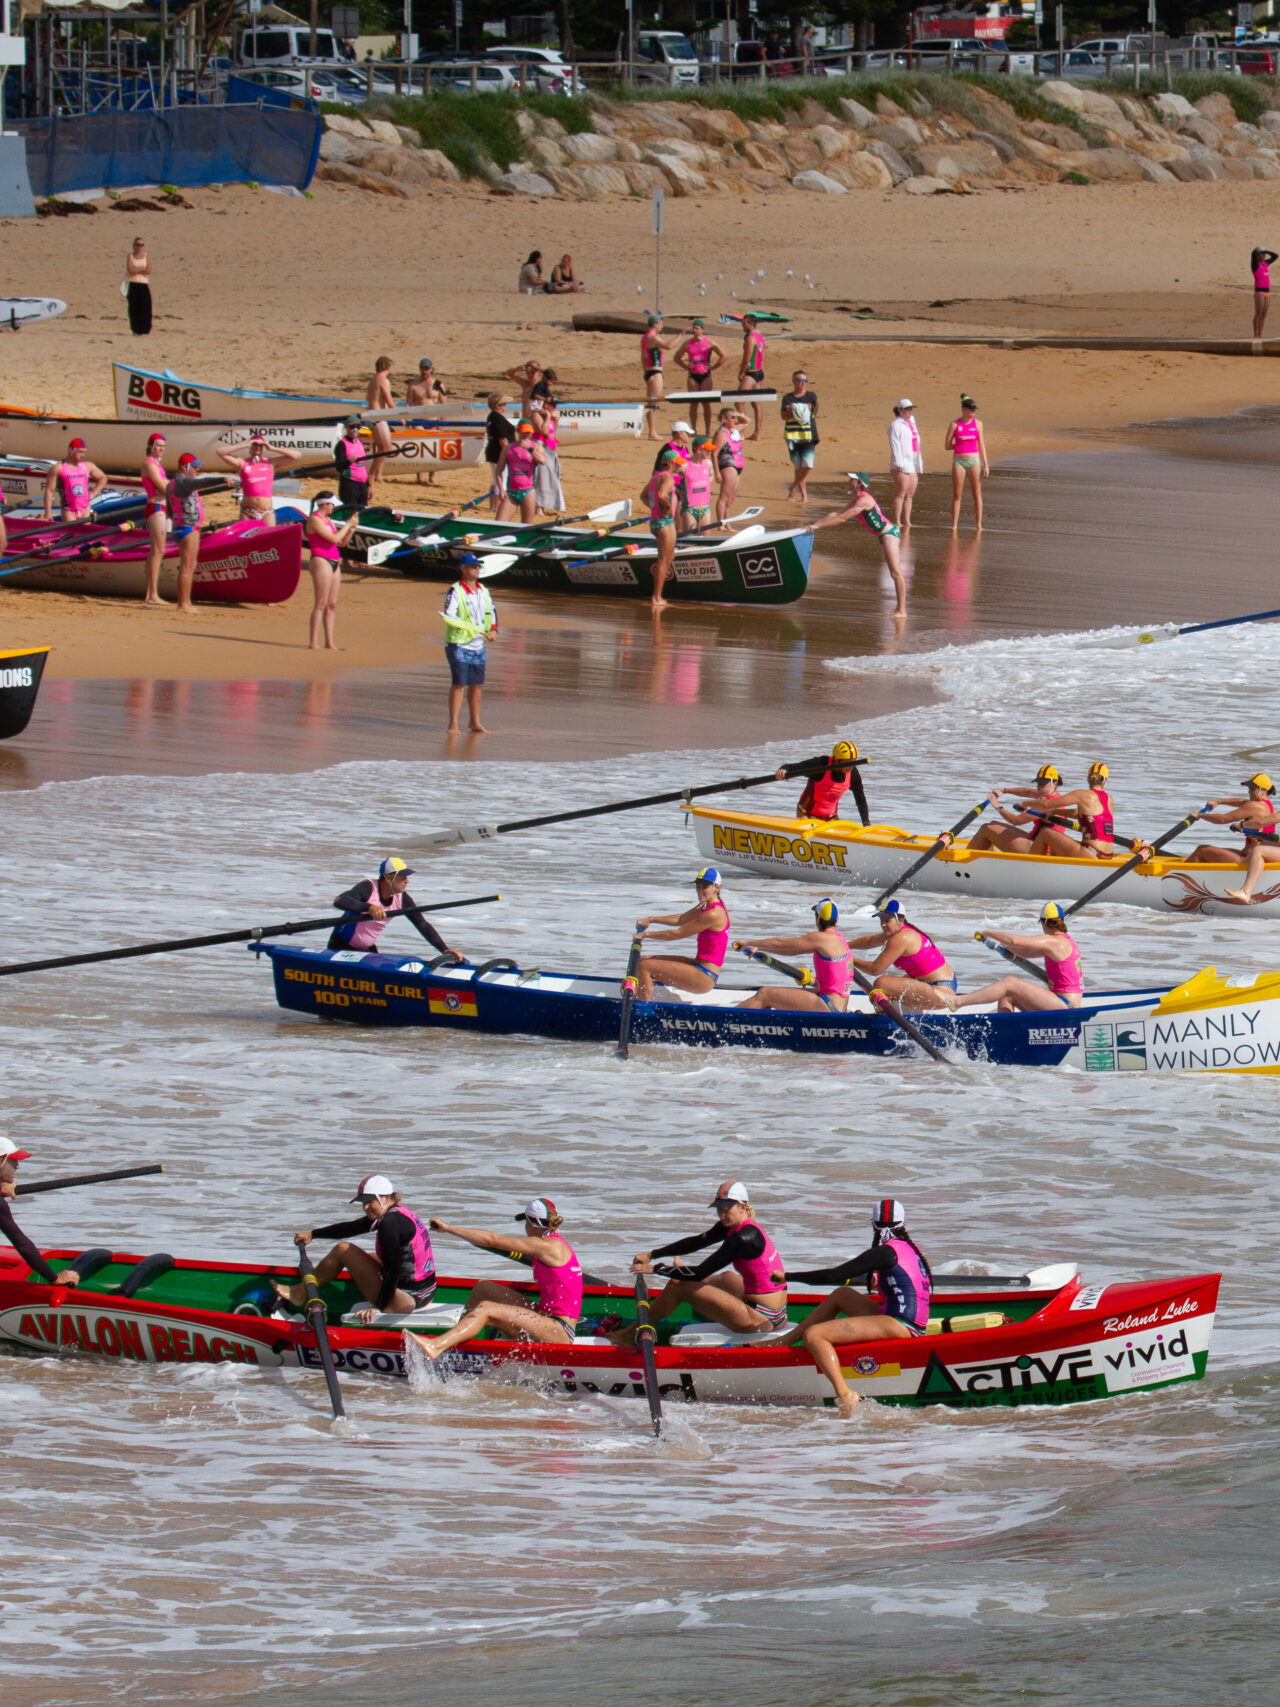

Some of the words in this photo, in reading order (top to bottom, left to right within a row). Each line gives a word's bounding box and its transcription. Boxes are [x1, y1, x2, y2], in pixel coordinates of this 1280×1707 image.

[128, 374, 201, 410] BORG
[560, 410, 601, 418] NORTH
[249, 428, 295, 437] NORTH
[677, 567, 697, 575] YOU
[700, 566, 717, 575] DIG
[713, 824, 849, 867] NEWPORT
[714, 849, 737, 858] SURF
[738, 852, 757, 861] LIFE
[758, 855, 789, 866] SAVING
[791, 860, 814, 870] CLUB
[284, 968, 335, 987] SOUTH
[339, 977, 380, 994] CURL
[384, 984, 426, 1000] CURL
[313, 990, 350, 1007] 100
[352, 995, 388, 1007] YEARS
[661, 1018, 718, 1032] KEVIN
[724, 1023, 794, 1036] "SPOOK"
[801, 1027, 869, 1039] MOFFAT
[1028, 1027, 1077, 1040] REILLY
[1152, 1009, 1261, 1046] MANLY
[1103, 1308, 1159, 1334] Roland
[1161, 1297, 1199, 1320] Luke
[18, 1313, 147, 1361] AVALON
[147, 1323, 260, 1364] BEACH
[1104, 1328, 1190, 1371] vivid
[1131, 1365, 1162, 1378] Commercial
[1163, 1360, 1186, 1371] Cleaning
[1137, 1373, 1159, 1383] Property
[1160, 1367, 1182, 1378] Services
